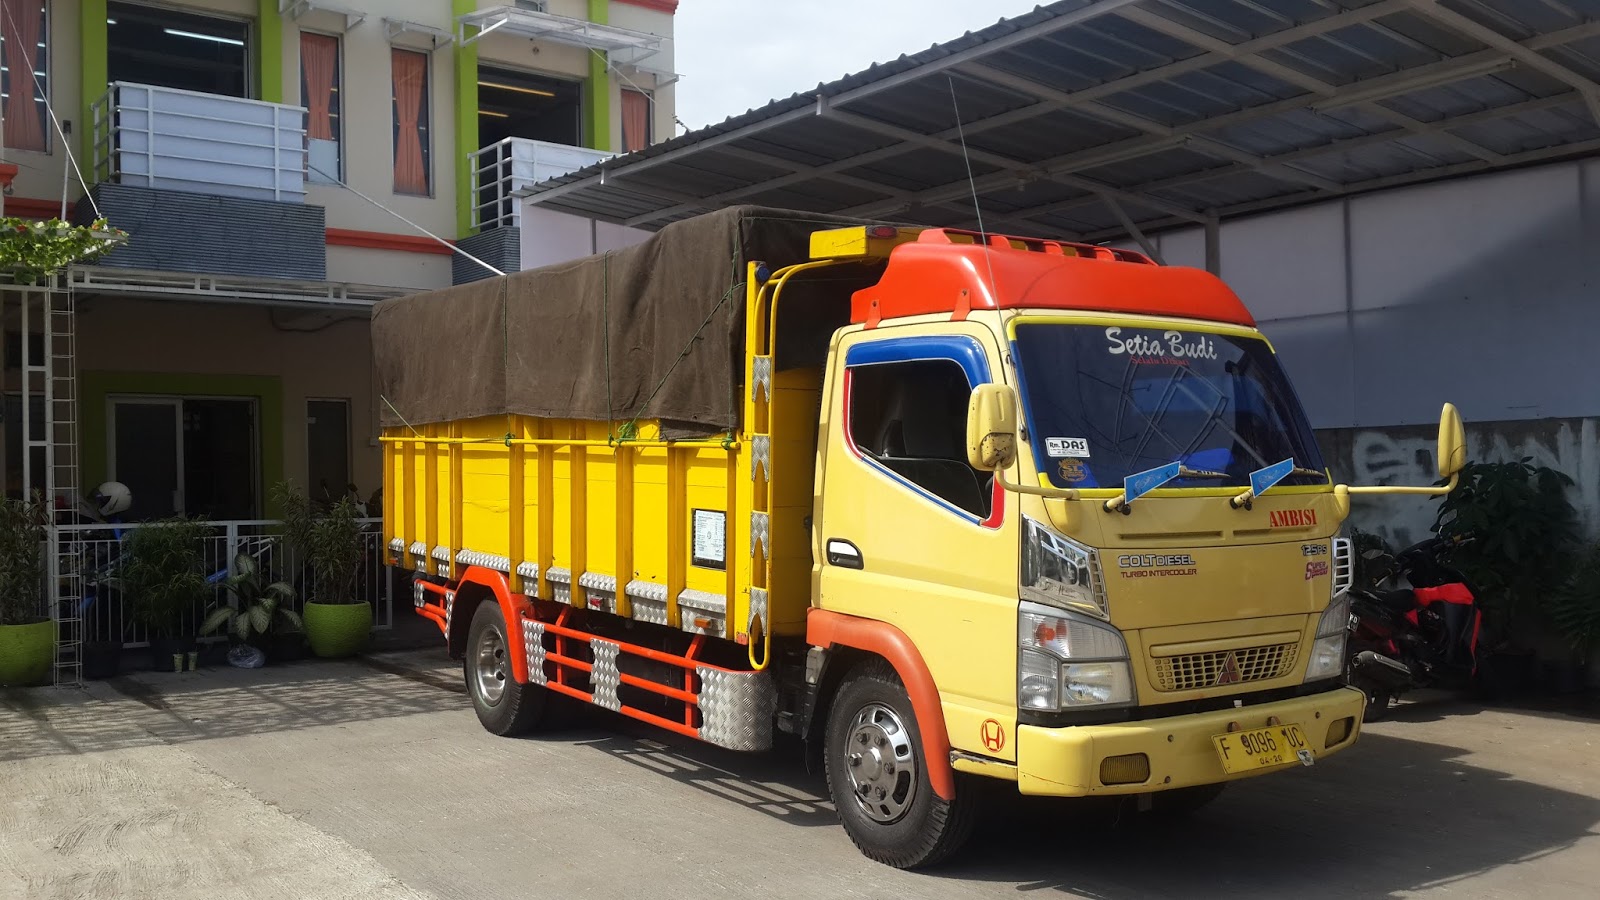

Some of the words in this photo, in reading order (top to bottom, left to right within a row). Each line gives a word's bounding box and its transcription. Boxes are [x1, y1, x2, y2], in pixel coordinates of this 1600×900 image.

[1105, 326, 1165, 356] Setia
[1164, 330, 1217, 359] Budi
[1061, 440, 1085, 450] DAS
[1270, 508, 1317, 528] AMBISI
[1301, 544, 1328, 557] 125PS
[1121, 570, 1148, 579] TURBO
[1149, 568, 1197, 577] INTERCOOLER
[1220, 737, 1231, 760] F
[1240, 730, 1277, 755] 9096
[1283, 726, 1304, 748] UC
